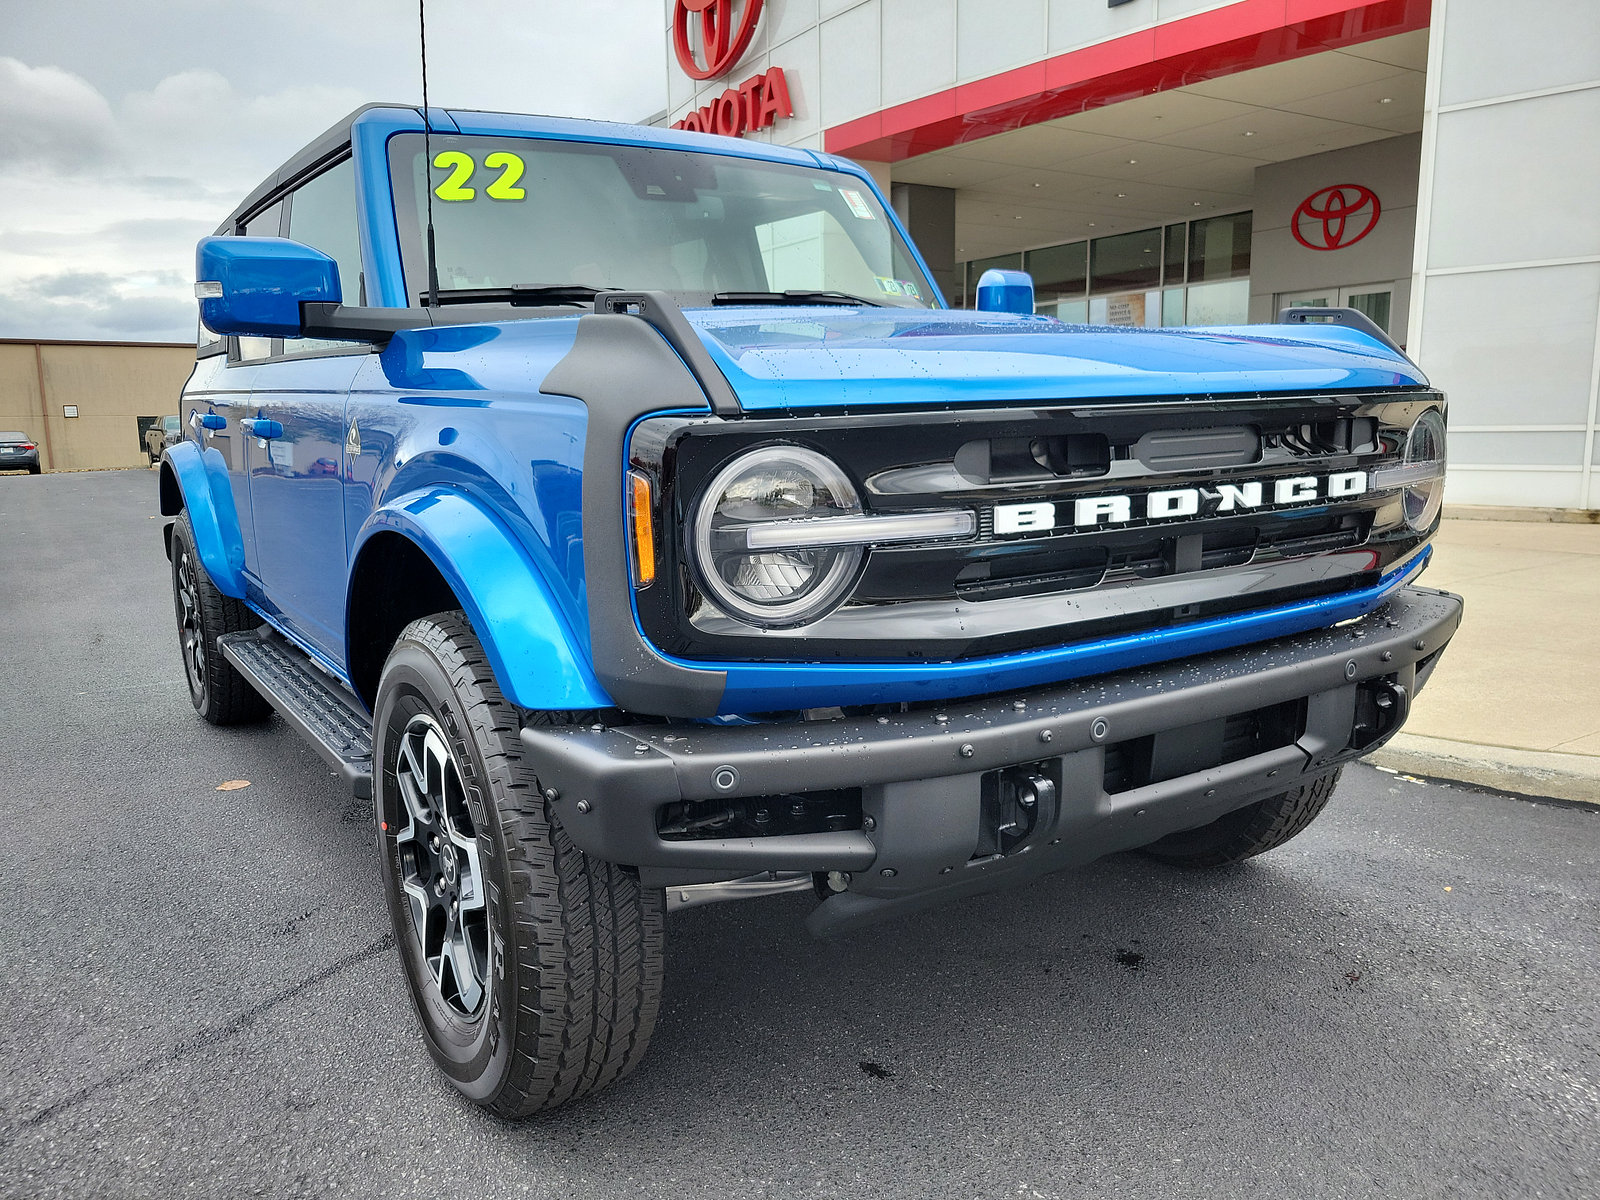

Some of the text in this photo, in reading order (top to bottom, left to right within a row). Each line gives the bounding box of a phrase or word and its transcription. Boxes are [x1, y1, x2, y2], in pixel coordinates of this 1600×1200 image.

[670, 66, 793, 138] YOTA
[433, 151, 525, 200] 22
[993, 470, 1367, 535] BRONCO
